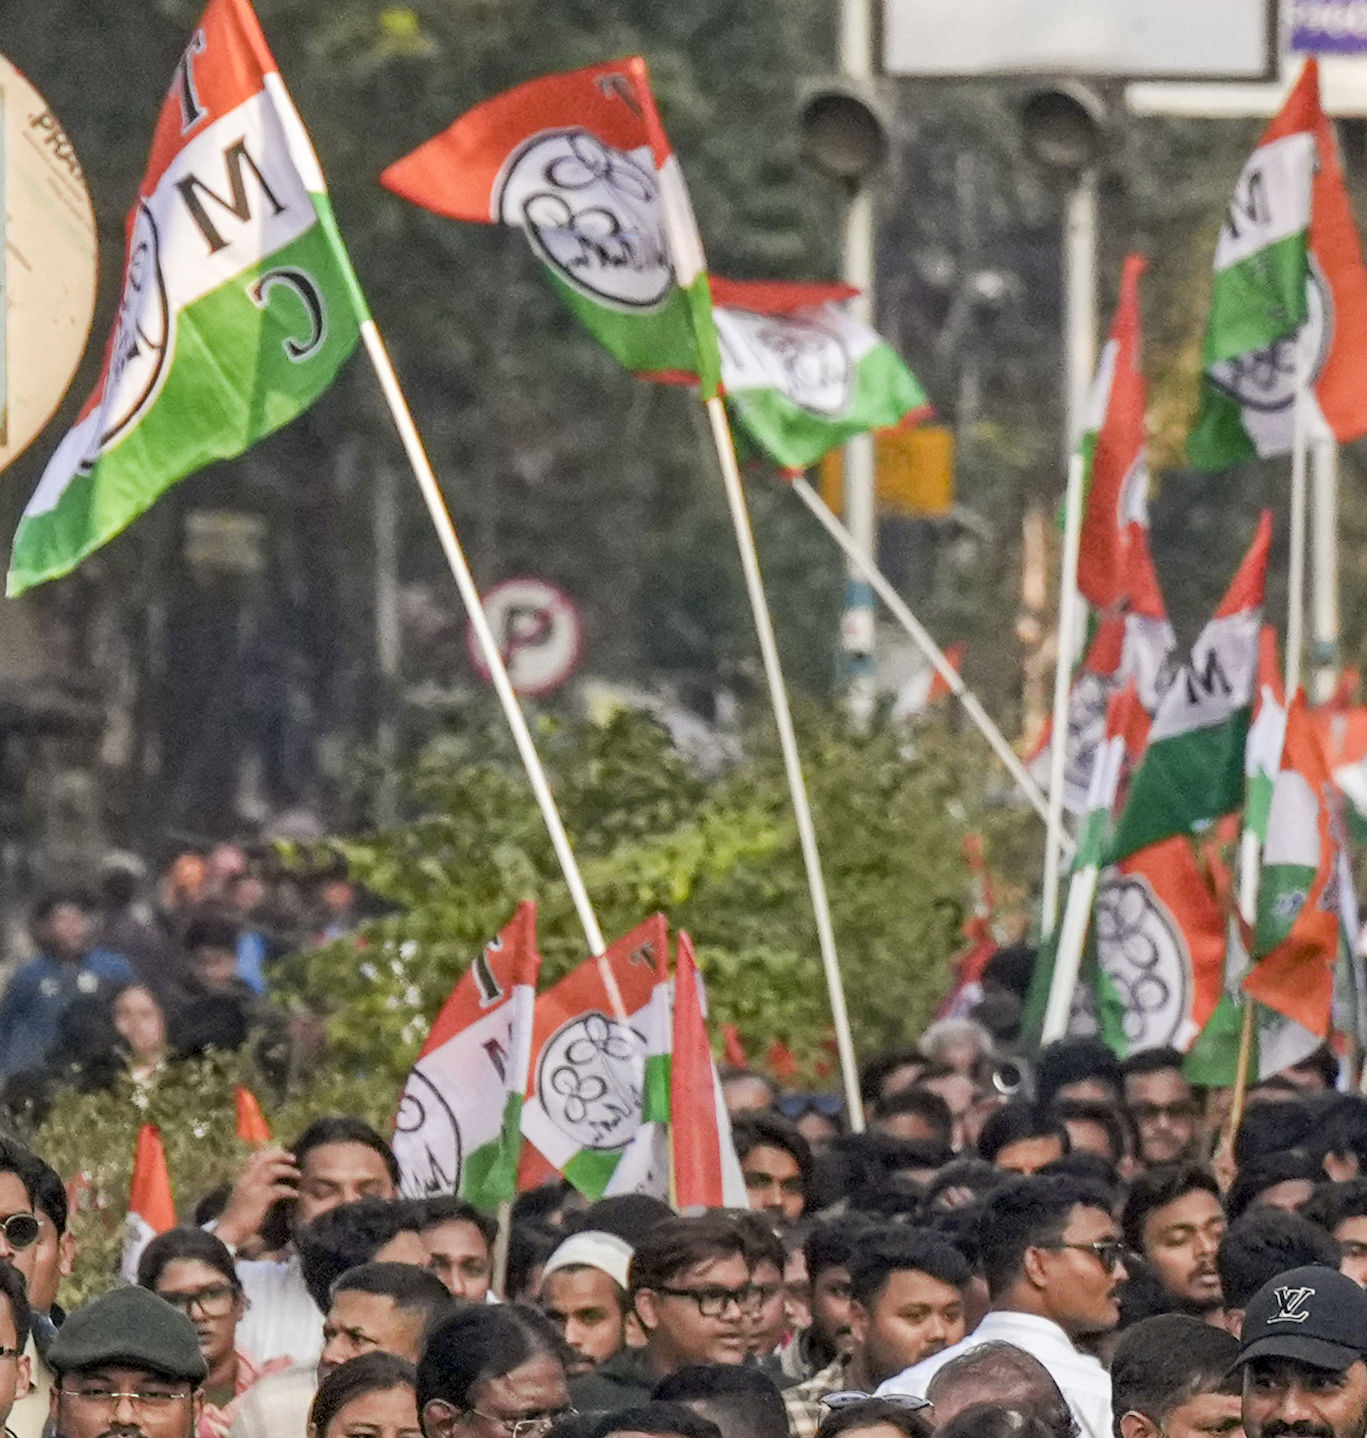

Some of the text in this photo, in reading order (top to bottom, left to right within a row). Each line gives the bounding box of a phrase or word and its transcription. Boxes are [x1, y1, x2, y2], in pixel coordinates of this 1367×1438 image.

[173, 134, 287, 256] M
[1186, 647, 1232, 705] M
[1266, 1285, 1316, 1325] LV
